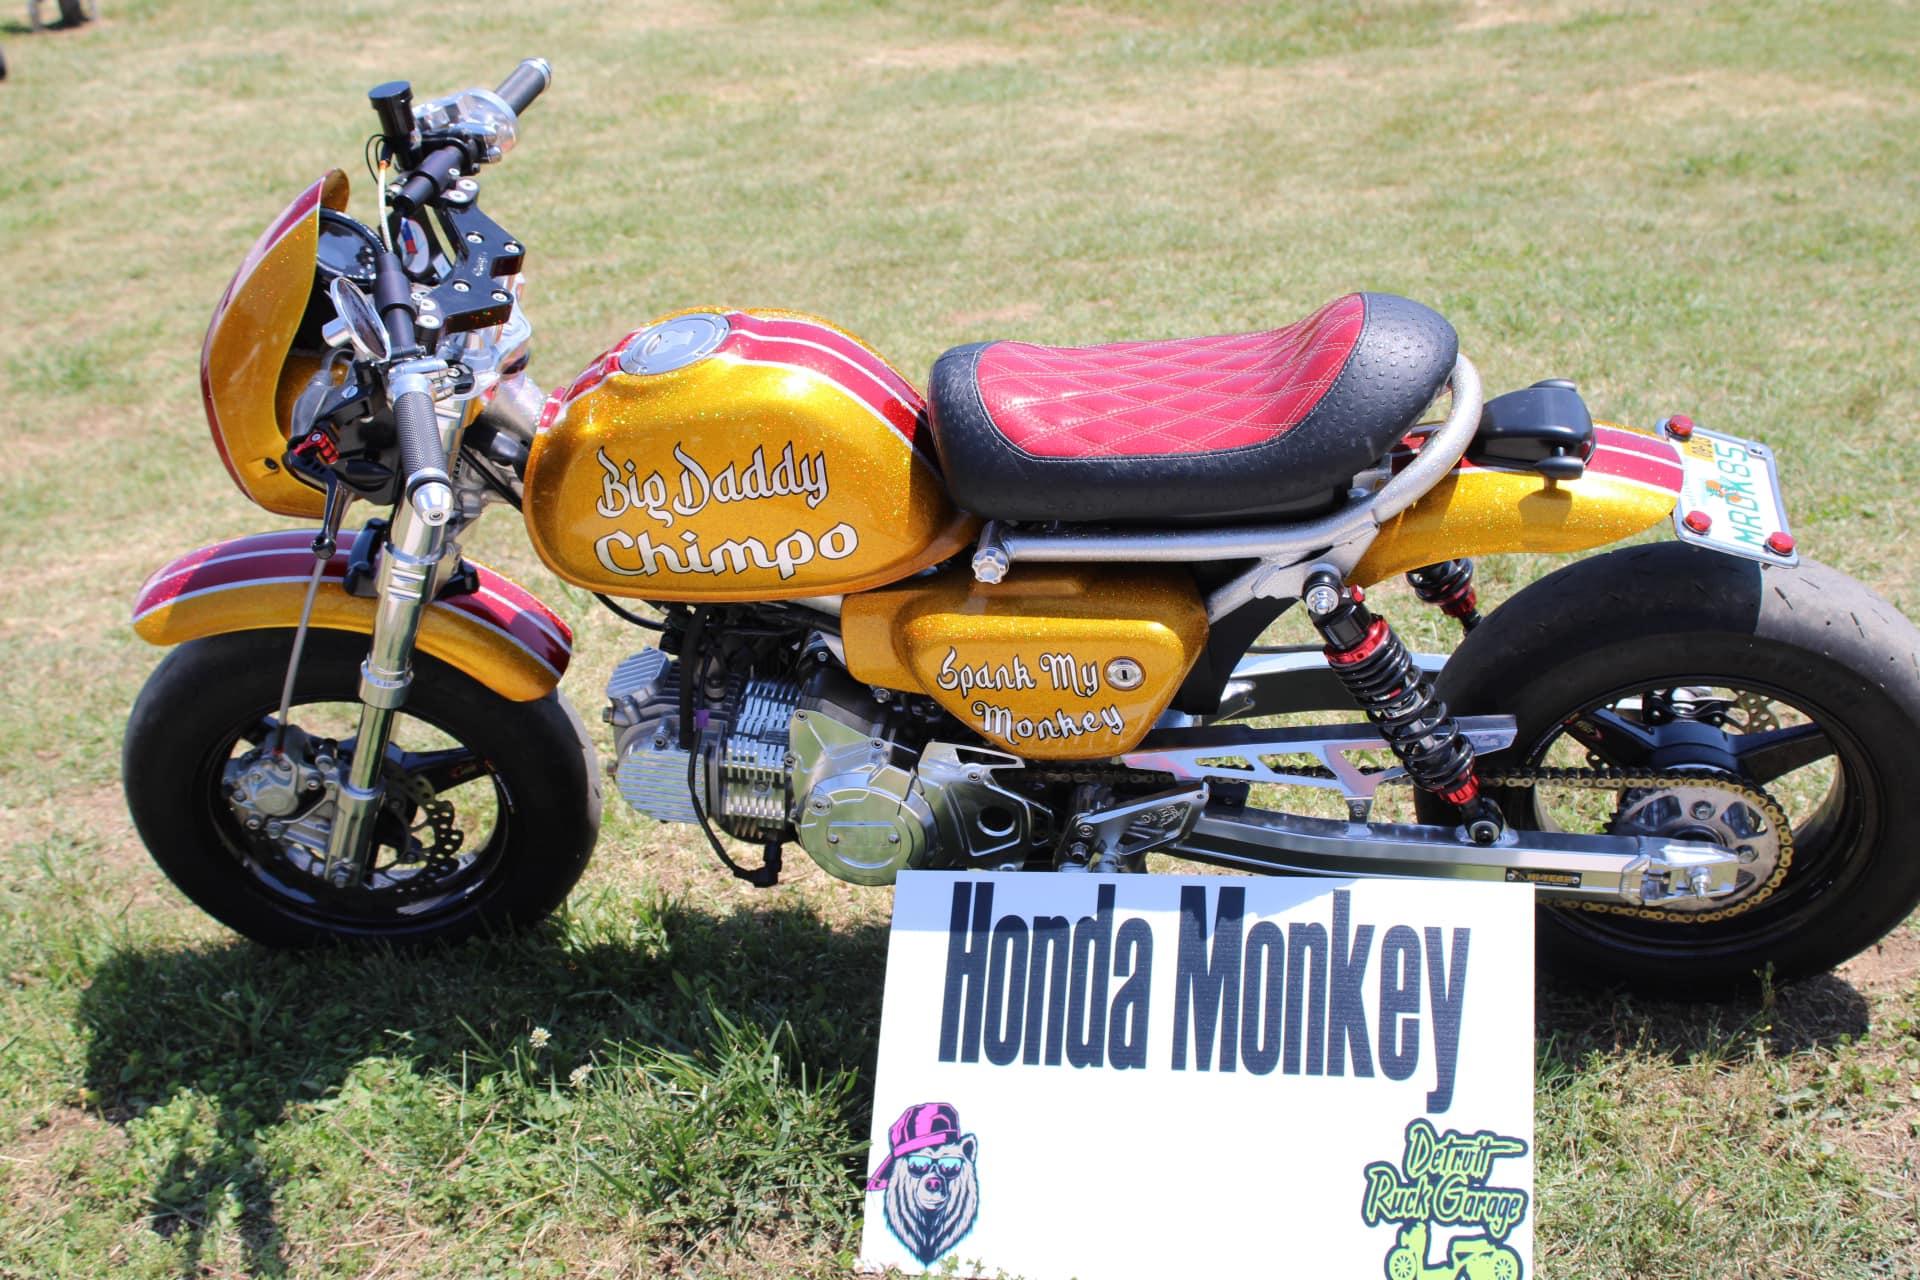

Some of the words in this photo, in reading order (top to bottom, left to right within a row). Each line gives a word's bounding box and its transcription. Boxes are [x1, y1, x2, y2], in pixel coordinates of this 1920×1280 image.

[596, 445, 674, 528] Big
[672, 440, 829, 516] Daddy
[593, 521, 859, 580] Chimpo
[937, 646, 1036, 698] Spank
[1039, 652, 1100, 697] My
[972, 700, 1125, 746] Monkey
[938, 881, 1154, 1070] Honda
[1171, 885, 1471, 1114] Monkey
[1365, 1165, 1434, 1223] Ruck
[1433, 1173, 1525, 1239] Garage
